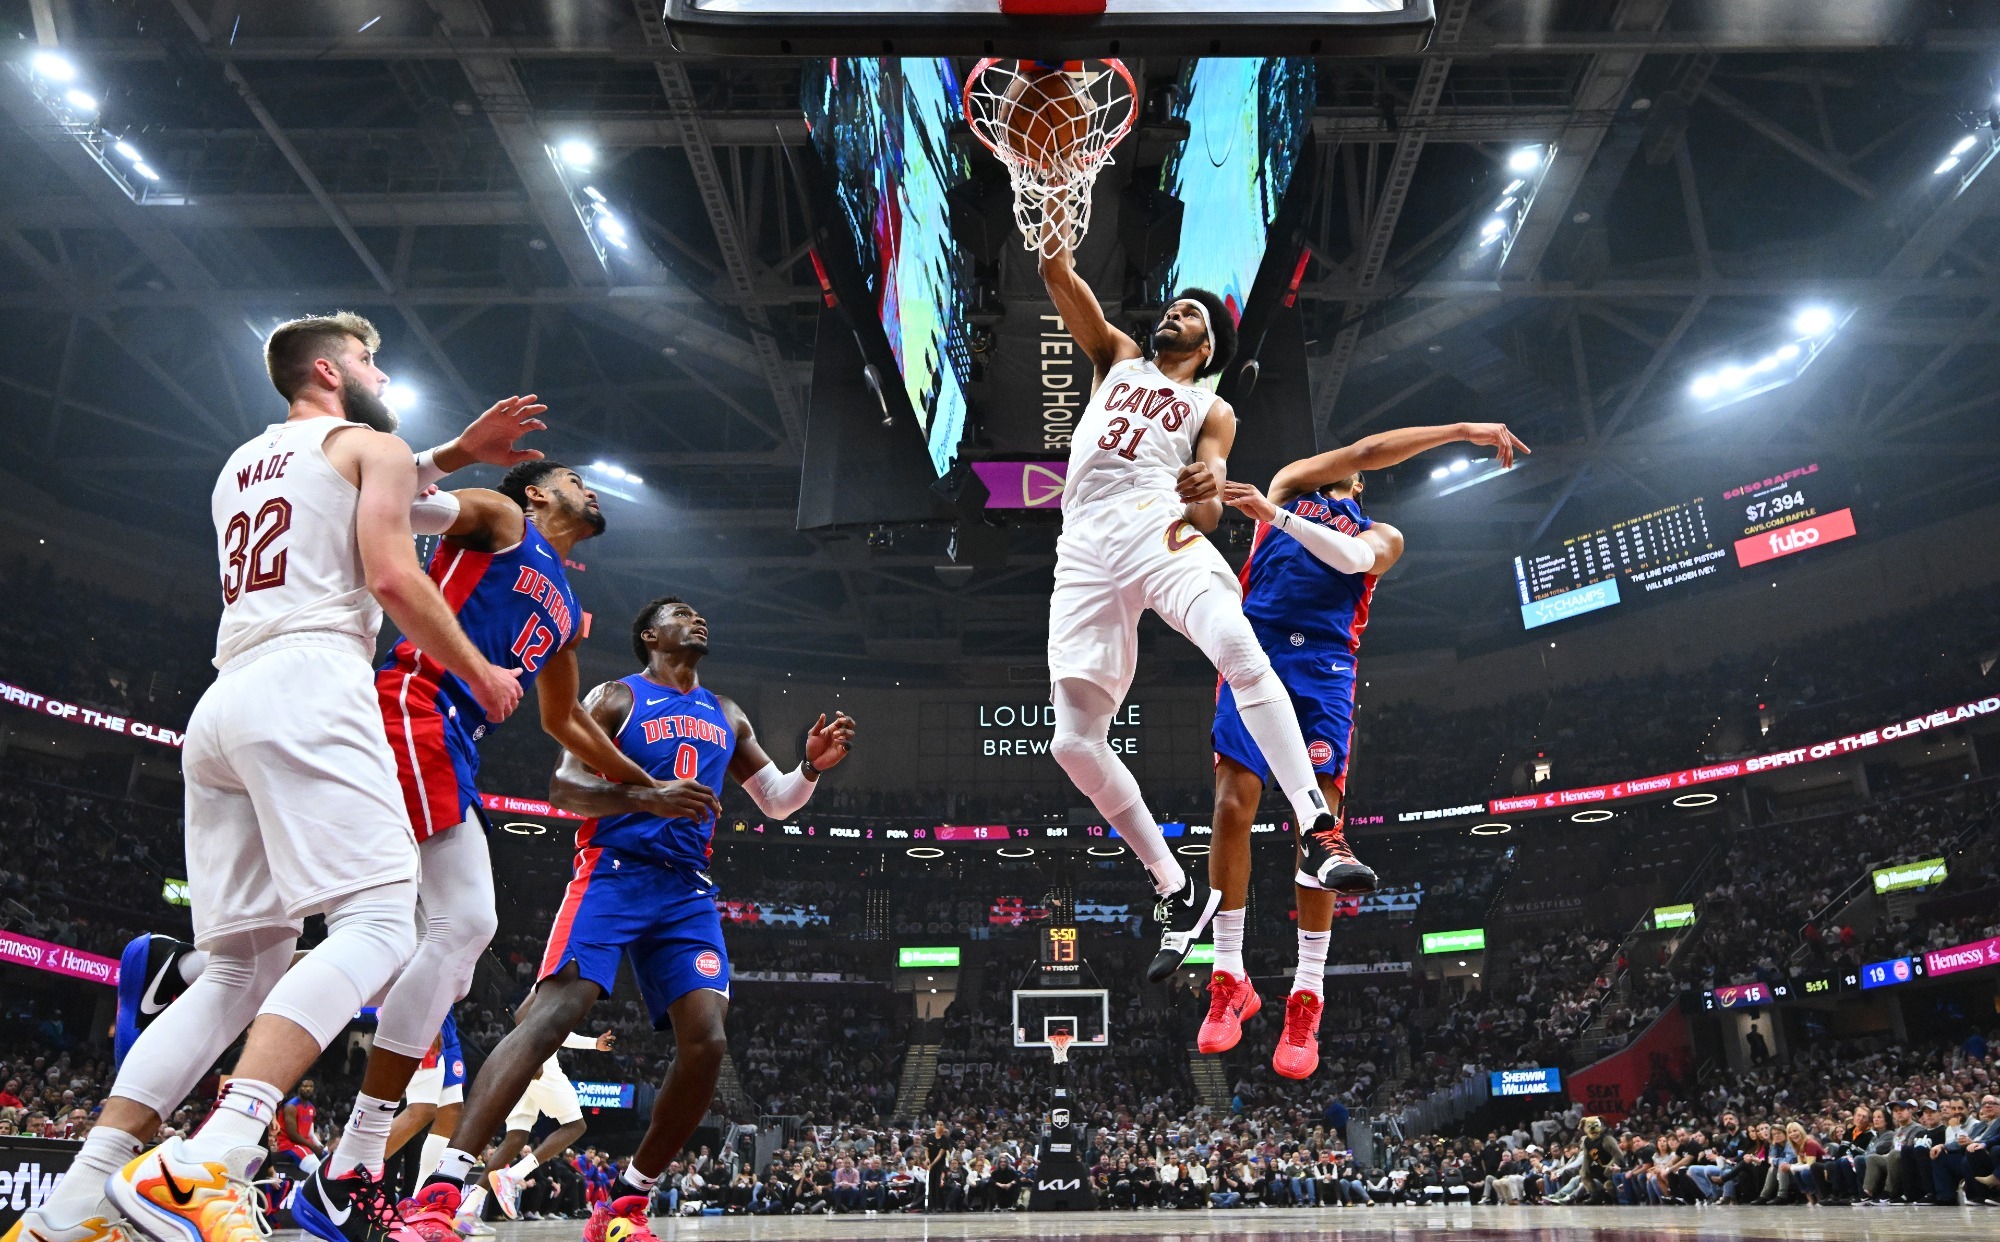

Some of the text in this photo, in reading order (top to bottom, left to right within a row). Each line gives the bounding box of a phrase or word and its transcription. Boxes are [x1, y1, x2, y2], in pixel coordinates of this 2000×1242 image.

[1104, 383, 1190, 432] CAVS
[1098, 416, 1149, 462] 31
[236, 452, 294, 492] WADE
[1763, 463, 1819, 488] RAFFLE
[1746, 491, 1804, 522] $7,394
[1744, 508, 1816, 534] CAVS.COM/RAFFLE
[224, 496, 293, 606] 32
[1769, 528, 1820, 554] fubo
[1631, 572, 1646, 583] THE
[1662, 564, 1678, 574] FOR
[1678, 558, 1694, 569] THE
[1694, 549, 1726, 564] PISTONS
[1554, 588, 1606, 612] CHAMPS
[1646, 581, 1662, 592] WILL
[512, 612, 554, 672] 12
[0, 683, 44, 709] PIRIT
[46, 700, 78, 718] OF
[81, 708, 125, 732] THE
[641, 715, 726, 750] DETROIT
[1746, 698, 2000, 772] SPIRIT OF THE CLEVELAND
[674, 742, 698, 780] 0
[1494, 764, 1740, 812] Hennessy Hennessy Hennessy Hennessy
[504, 798, 551, 815] Hennessy
[1350, 817, 1368, 826] 7:54
[1370, 816, 1384, 824] PM
[1398, 812, 1422, 822] LET
[808, 826, 814, 836] 6
[830, 828, 860, 838] FOULS
[866, 829, 873, 838] 2
[914, 829, 926, 838] 50
[973, 828, 988, 838] 15
[1016, 829, 1029, 837] 13
[1086, 826, 1103, 837] 1Q
[1282, 822, 1289, 831] 0
[1050, 929, 1076, 940] 5:50
[0, 938, 112, 982] ennessy Hennessy
[1054, 941, 1074, 962] 13
[1706, 1000, 1713, 1010] 2
[1744, 987, 1760, 1002] 15
[1806, 979, 1829, 992] 5:51
[1845, 975, 1856, 986] 13
[1870, 966, 1886, 983] 19
[1915, 965, 1922, 976] 0
[1929, 948, 1984, 972] Hennessy
[576, 1082, 622, 1096] SHERWIN
[1502, 1070, 1546, 1084] SHERWIN
[1586, 1084, 1620, 1098] SEAT
[1586, 1100, 1626, 1114] GEEK
[0, 1162, 66, 1211] etw
